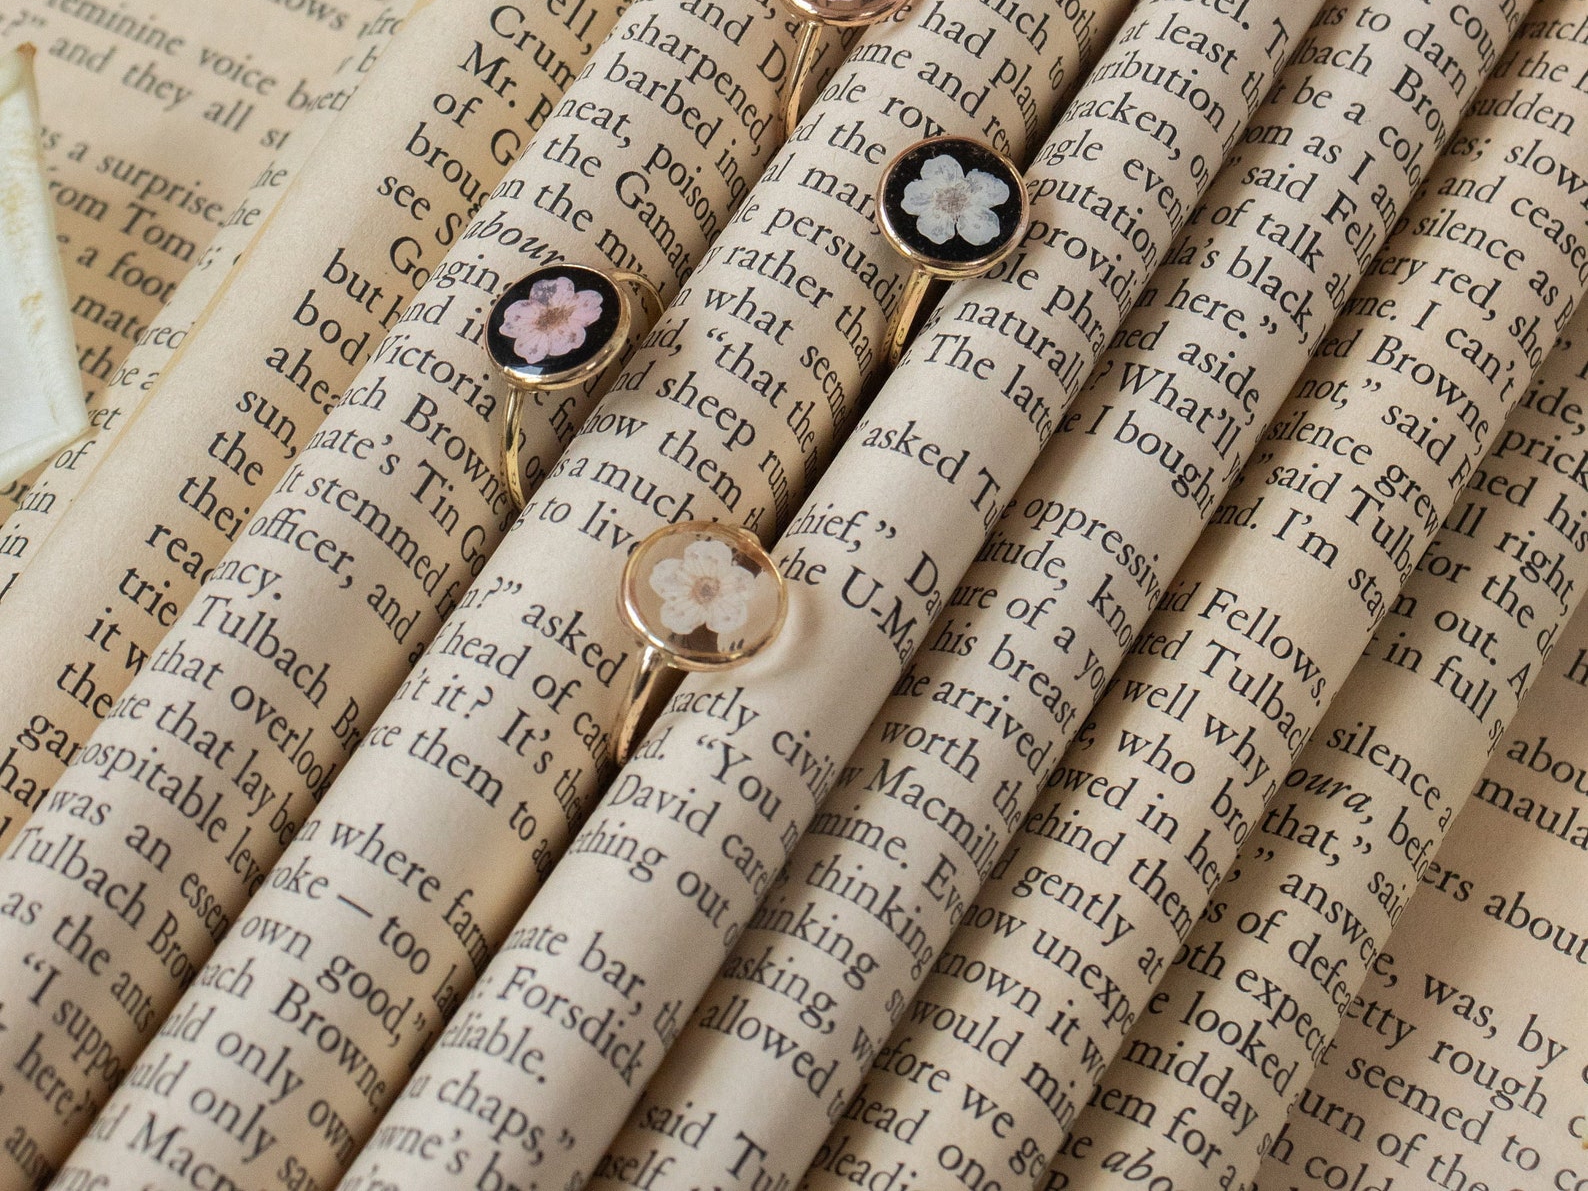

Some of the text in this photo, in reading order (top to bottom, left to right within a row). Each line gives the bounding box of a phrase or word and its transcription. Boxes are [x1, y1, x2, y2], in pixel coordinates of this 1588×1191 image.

[918, 0, 997, 59] had
[1155, 12, 1237, 74] least
[1355, 6, 1470, 99] to darn
[49, 35, 255, 132] and they all
[199, 47, 278, 95] voice
[458, 40, 517, 108] Mr.
[604, 51, 724, 149] barbed
[621, 14, 774, 157] sharpened,
[917, 60, 990, 119] and
[1292, 75, 1366, 126] be a
[432, 93, 484, 128] of
[555, 97, 631, 148] neat,
[827, 120, 886, 165] the
[543, 133, 602, 178] the
[1241, 163, 1318, 203] said
[1303, 135, 1376, 186] as I
[377, 175, 431, 221] see
[532, 183, 593, 231] the
[1437, 175, 1507, 204] and
[120, 201, 196, 263] Tom
[1210, 198, 1325, 273] of talk
[1412, 208, 1526, 270] silence
[322, 248, 383, 313] but
[722, 245, 834, 309] rather
[1226, 245, 1314, 344] black,
[1431, 266, 1502, 321] red,
[704, 286, 794, 346] what
[1411, 299, 1442, 331] I
[373, 334, 499, 422] Victoria
[924, 332, 996, 381] The
[1177, 341, 1259, 425] aside,
[235, 390, 298, 459] sun,
[655, 371, 757, 451] sheep
[1085, 405, 1113, 436] I
[1367, 334, 1489, 456] Browne,
[207, 431, 264, 486] the
[862, 420, 971, 484] asked
[1265, 410, 1373, 465] silence
[1381, 404, 1456, 467] said
[410, 459, 460, 536] Tin
[658, 429, 742, 513] them
[1265, 463, 1342, 504] said
[539, 496, 571, 523] to
[1272, 508, 1339, 569] I'm
[249, 507, 354, 589] officer,
[84, 606, 122, 652] it
[367, 583, 421, 645] and
[1005, 597, 1076, 654] of a
[1480, 574, 1535, 629] the
[151, 639, 224, 689] that
[192, 594, 331, 709] Tulbach
[440, 621, 581, 714] head of
[521, 604, 628, 688] asked
[1434, 610, 1498, 666] out.
[56, 662, 114, 719] the
[1382, 631, 1498, 723] in full
[432, 674, 553, 774] it? It's
[931, 680, 1053, 775] arrived
[1120, 679, 1269, 787] well why
[155, 701, 276, 817] that lay
[408, 727, 537, 841] them to
[1117, 729, 1196, 785] who
[1326, 721, 1441, 810] silence
[48, 789, 171, 873] was an
[607, 774, 721, 838] David
[1136, 793, 1179, 844] in
[7, 826, 148, 930] Tulbach
[331, 822, 440, 903] where
[676, 870, 730, 929] out
[1011, 865, 1135, 947] gently
[1237, 909, 1288, 944] of
[52, 914, 111, 976] the
[240, 916, 313, 962] own
[379, 915, 431, 975] too
[579, 931, 645, 1015] bar,
[722, 946, 837, 1034] asking,
[497, 966, 645, 1087] Forsdick
[700, 995, 839, 1098] allowed
[910, 999, 1024, 1068] would
[1045, 999, 1080, 1047] it
[1179, 990, 1299, 1097] looked
[1423, 973, 1568, 1070] was, by
[216, 1031, 303, 1104] only
[1121, 1038, 1259, 1137] midday
[1428, 1040, 1548, 1119] rough
[190, 1088, 277, 1164] only
[960, 1084, 1015, 1139] we
[1345, 1056, 1541, 1171] seemed to
[1376, 1132, 1428, 1169] of
